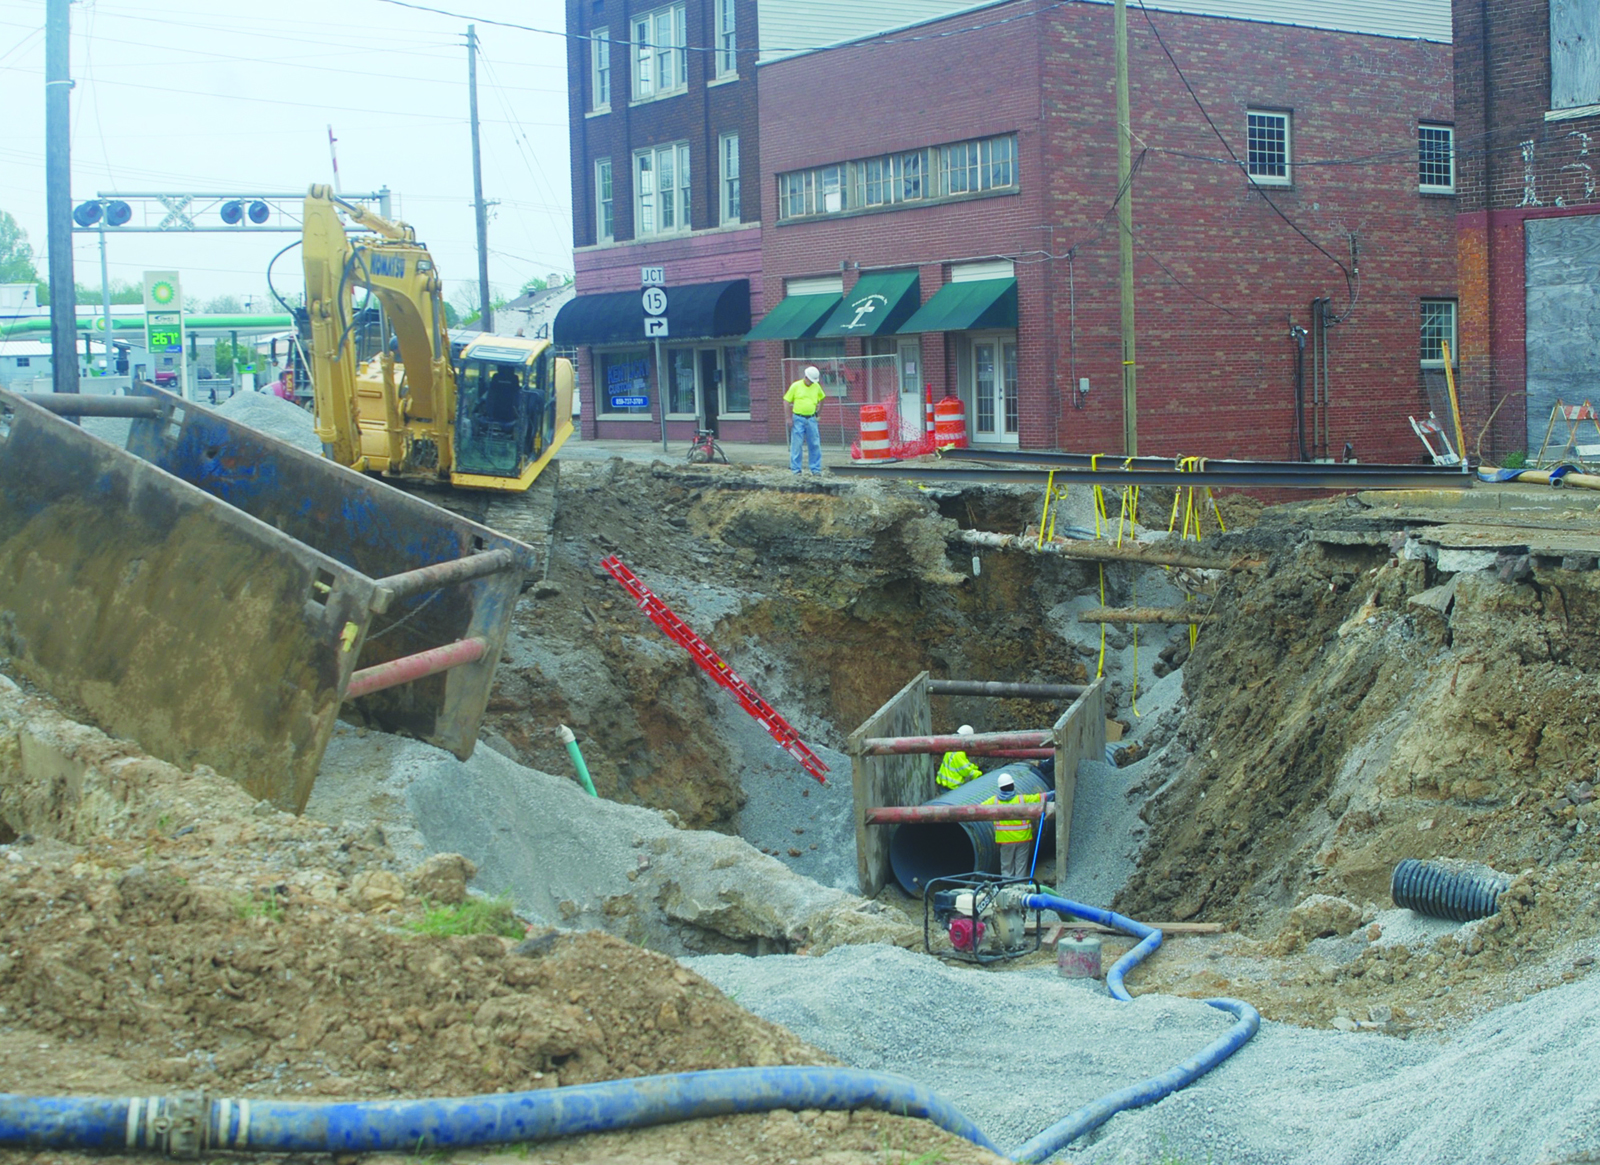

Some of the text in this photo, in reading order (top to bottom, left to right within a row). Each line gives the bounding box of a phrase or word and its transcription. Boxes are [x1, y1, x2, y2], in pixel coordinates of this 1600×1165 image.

[643, 269, 663, 282] JCT
[647, 293, 663, 310] 15
[976, 884, 999, 914] KOSN
